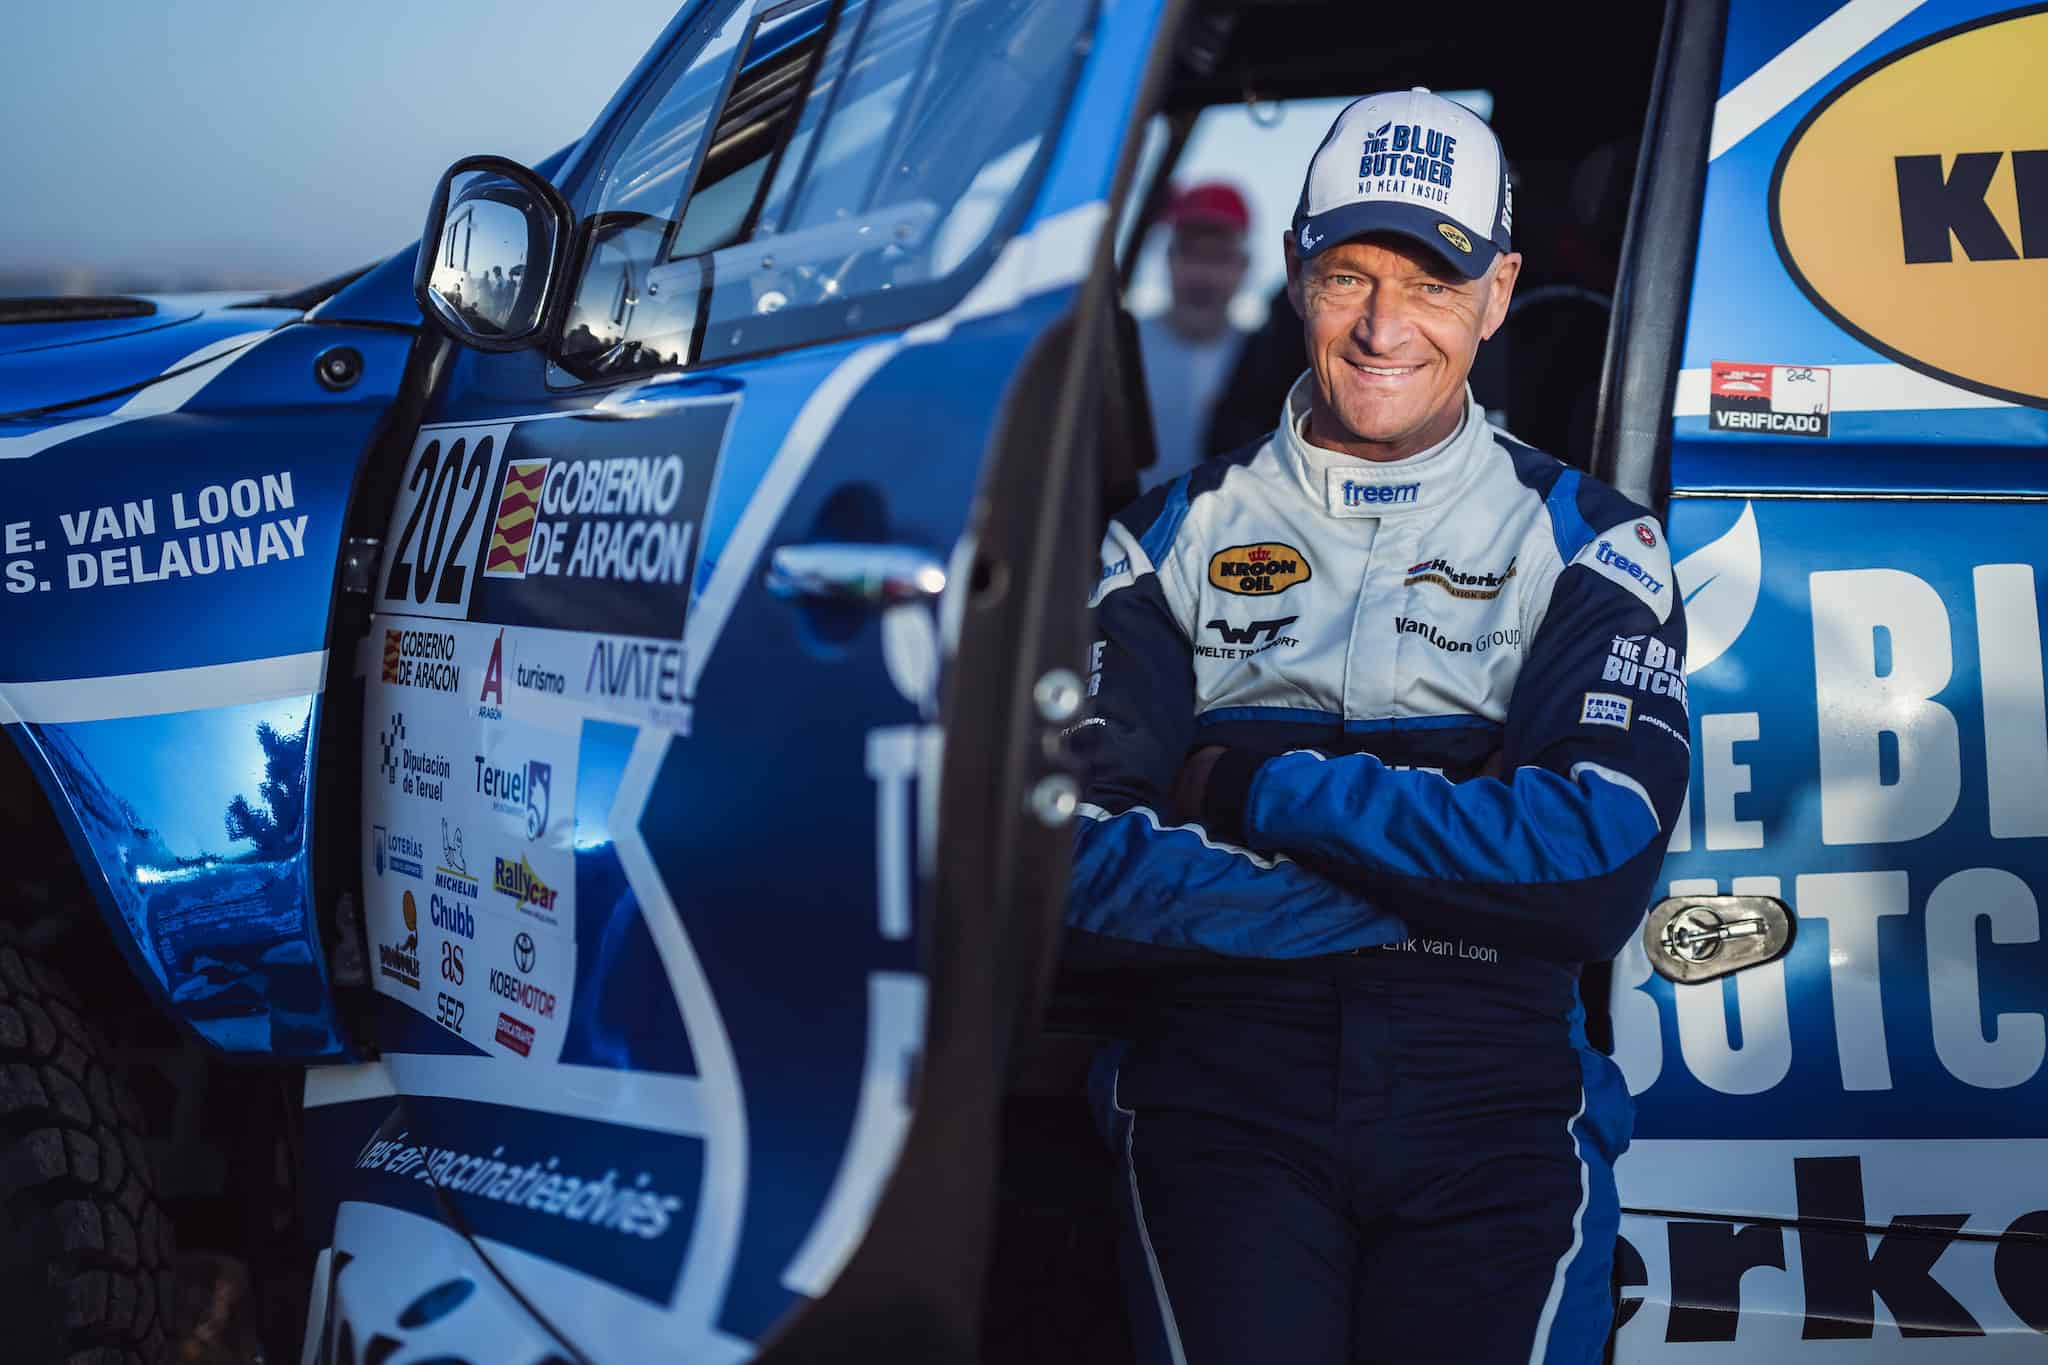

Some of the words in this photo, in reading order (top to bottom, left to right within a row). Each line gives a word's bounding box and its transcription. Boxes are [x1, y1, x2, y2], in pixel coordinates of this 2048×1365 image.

[1362, 138, 1389, 155] THE
[1391, 124, 1457, 165] BLUE
[1359, 153, 1453, 189] BUTCHER
[1357, 180, 1372, 195] NO
[1377, 179, 1406, 193] MEAT
[1411, 183, 1449, 205] INSIDE
[1716, 410, 1822, 432] VERIFICADO
[542, 453, 685, 516] GOBIERNO
[1343, 479, 1421, 505] freem
[4, 520, 47, 555] E.
[59, 498, 156, 547] VAN
[171, 471, 296, 530] LOON
[384, 434, 495, 605] 202
[5, 559, 51, 594] S.
[66, 514, 309, 590] DELAUNAY
[527, 520, 567, 577] DE
[565, 520, 694, 585] ARAGON
[1220, 559, 1297, 576] KROON
[1596, 541, 1663, 594] freem
[1239, 576, 1274, 591] OIL
[400, 629, 455, 662] GOBIERNO
[1194, 645, 1236, 660] WELTE
[1475, 629, 1521, 651] Group
[1611, 639, 1641, 663] THE
[397, 660, 412, 687] DE
[414, 664, 460, 693] ARAGON
[517, 664, 565, 695] turismo
[403, 749, 450, 779] Diputación
[475, 755, 528, 805] Teruel
[402, 775, 414, 795] de
[416, 775, 443, 802] Teruel
[435, 873, 479, 899] MICHELIN
[430, 893, 475, 940] Chubb
[441, 940, 465, 987] as
[1422, 938, 1454, 956] van
[1459, 941, 1498, 962] Loon
[489, 967, 557, 1020] KOBEMOTOR
